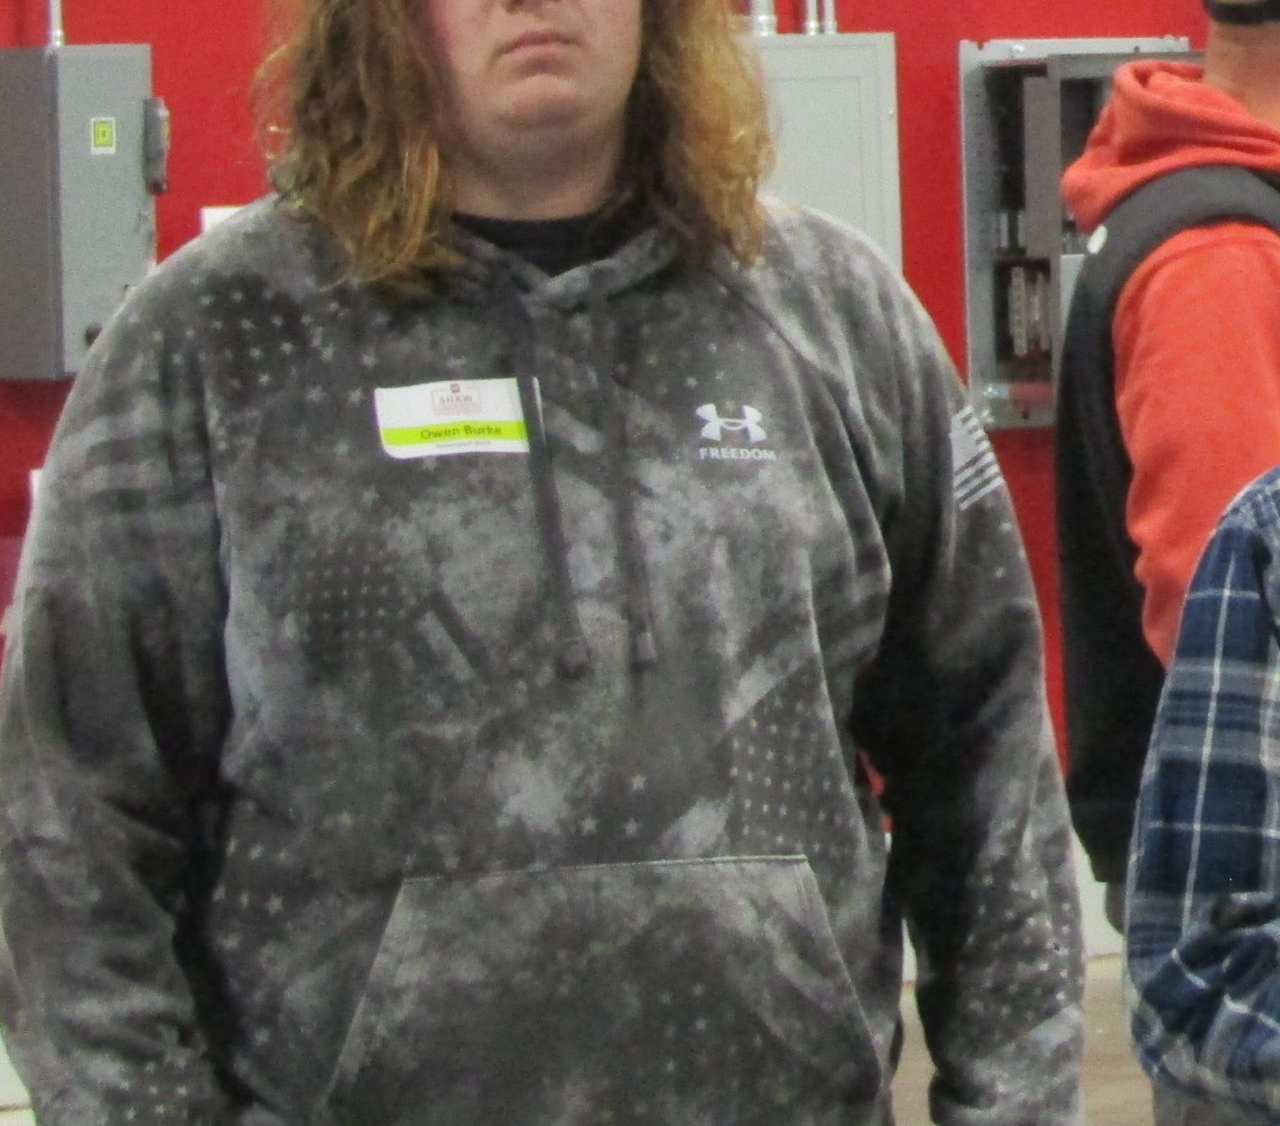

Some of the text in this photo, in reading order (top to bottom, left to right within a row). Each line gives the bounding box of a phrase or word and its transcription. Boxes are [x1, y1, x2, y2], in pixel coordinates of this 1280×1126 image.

[420, 425, 502, 439] Owen Burke
[699, 447, 777, 461] FREEDOM
